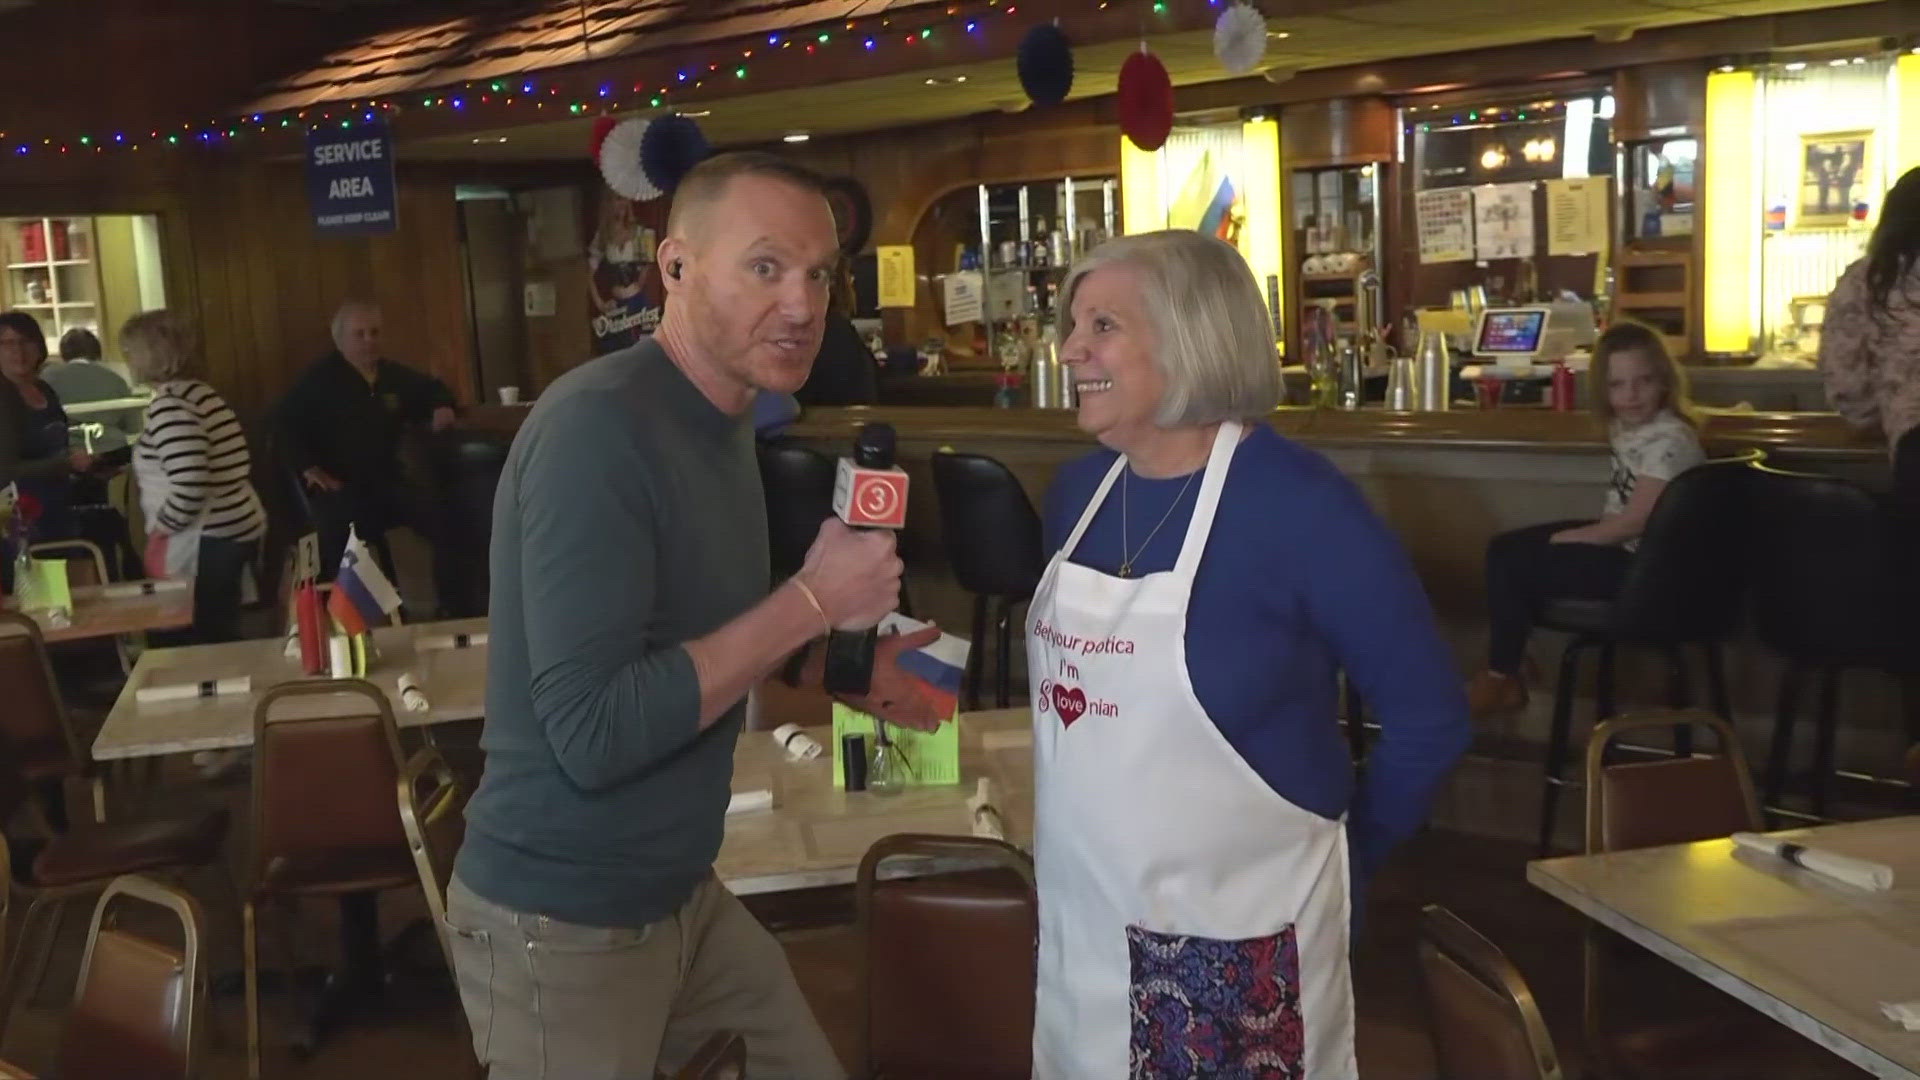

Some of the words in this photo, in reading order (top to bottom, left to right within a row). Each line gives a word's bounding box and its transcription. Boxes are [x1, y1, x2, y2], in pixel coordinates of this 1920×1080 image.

[314, 139, 382, 166] SERVICE
[328, 176, 375, 200] AREA
[869, 486, 885, 512] 3
[1050, 630, 1082, 650] your
[1082, 635, 1134, 656] potica
[1059, 659, 1079, 680] I'm
